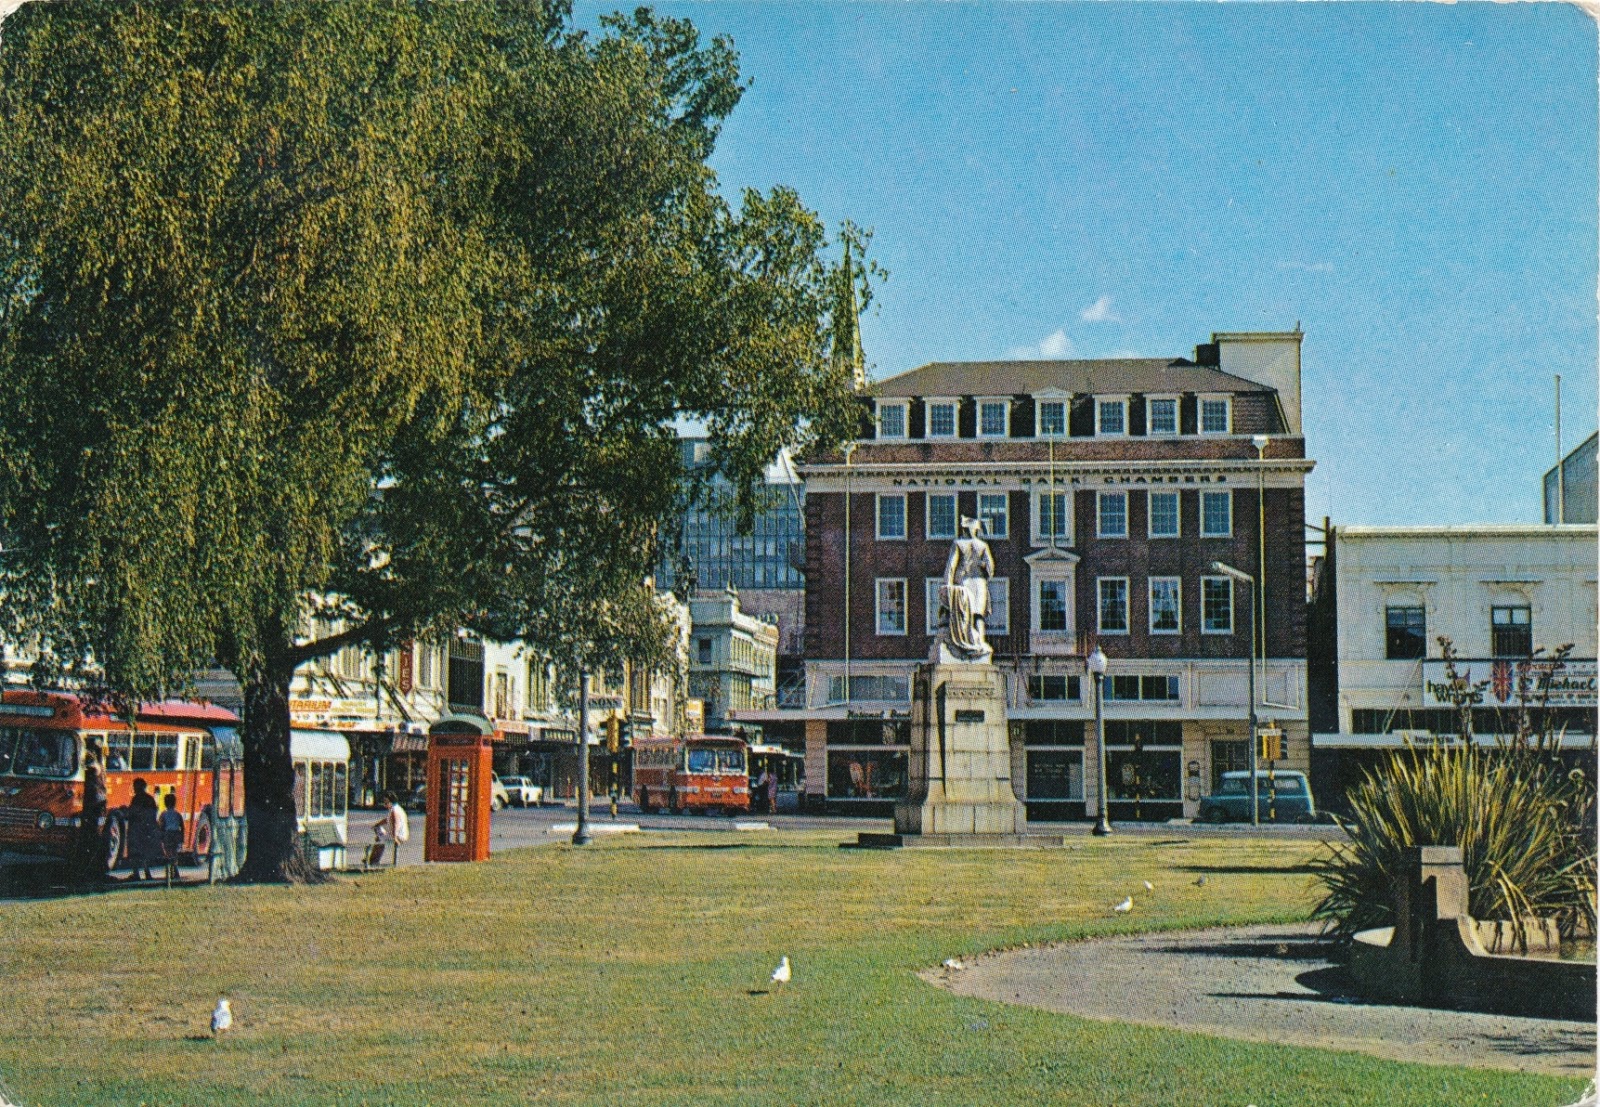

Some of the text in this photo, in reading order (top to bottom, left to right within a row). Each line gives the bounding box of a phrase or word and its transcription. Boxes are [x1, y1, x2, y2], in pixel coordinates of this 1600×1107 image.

[893, 475, 1227, 486] NATIONAL BANK CHAMBERS
